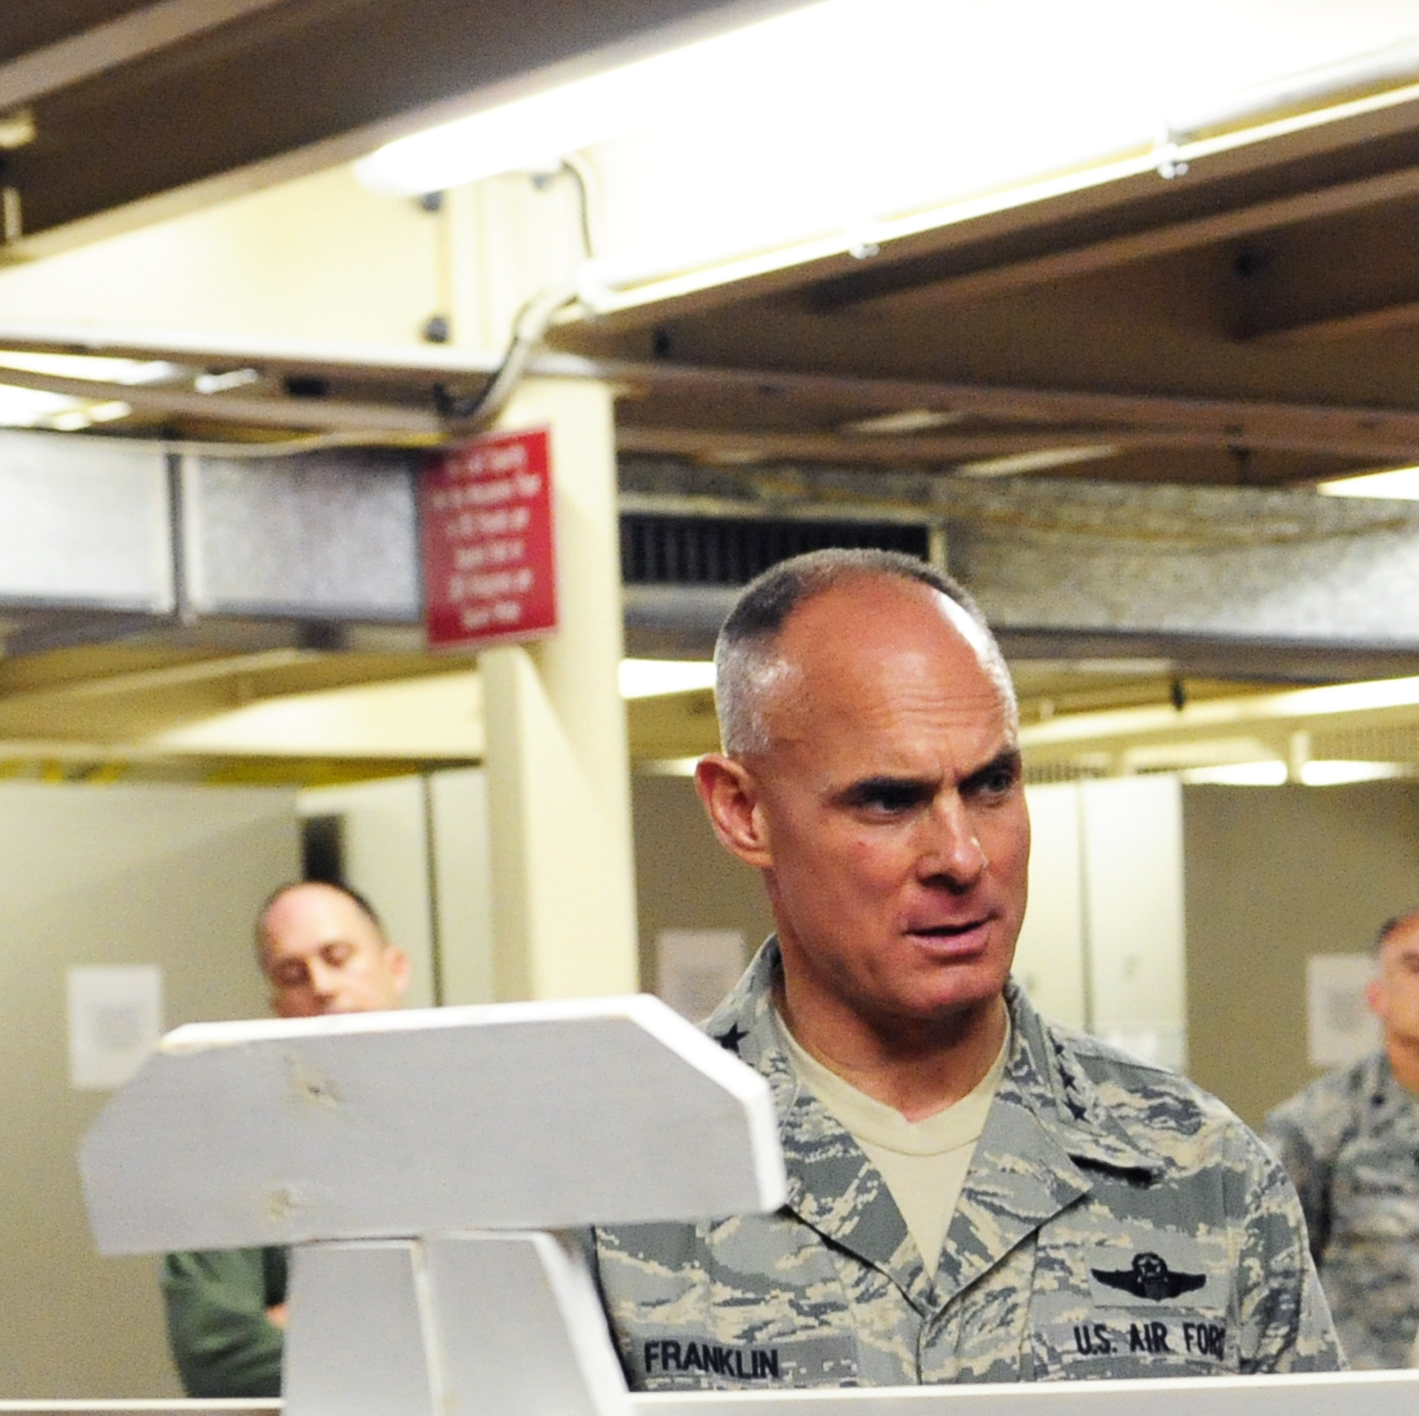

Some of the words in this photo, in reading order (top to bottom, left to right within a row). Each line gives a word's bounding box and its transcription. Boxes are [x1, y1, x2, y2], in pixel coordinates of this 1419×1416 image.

[1073, 1323, 1118, 1355] U.S.
[1130, 1320, 1172, 1354] AIR
[643, 1339, 779, 1380] FRANKLIN
